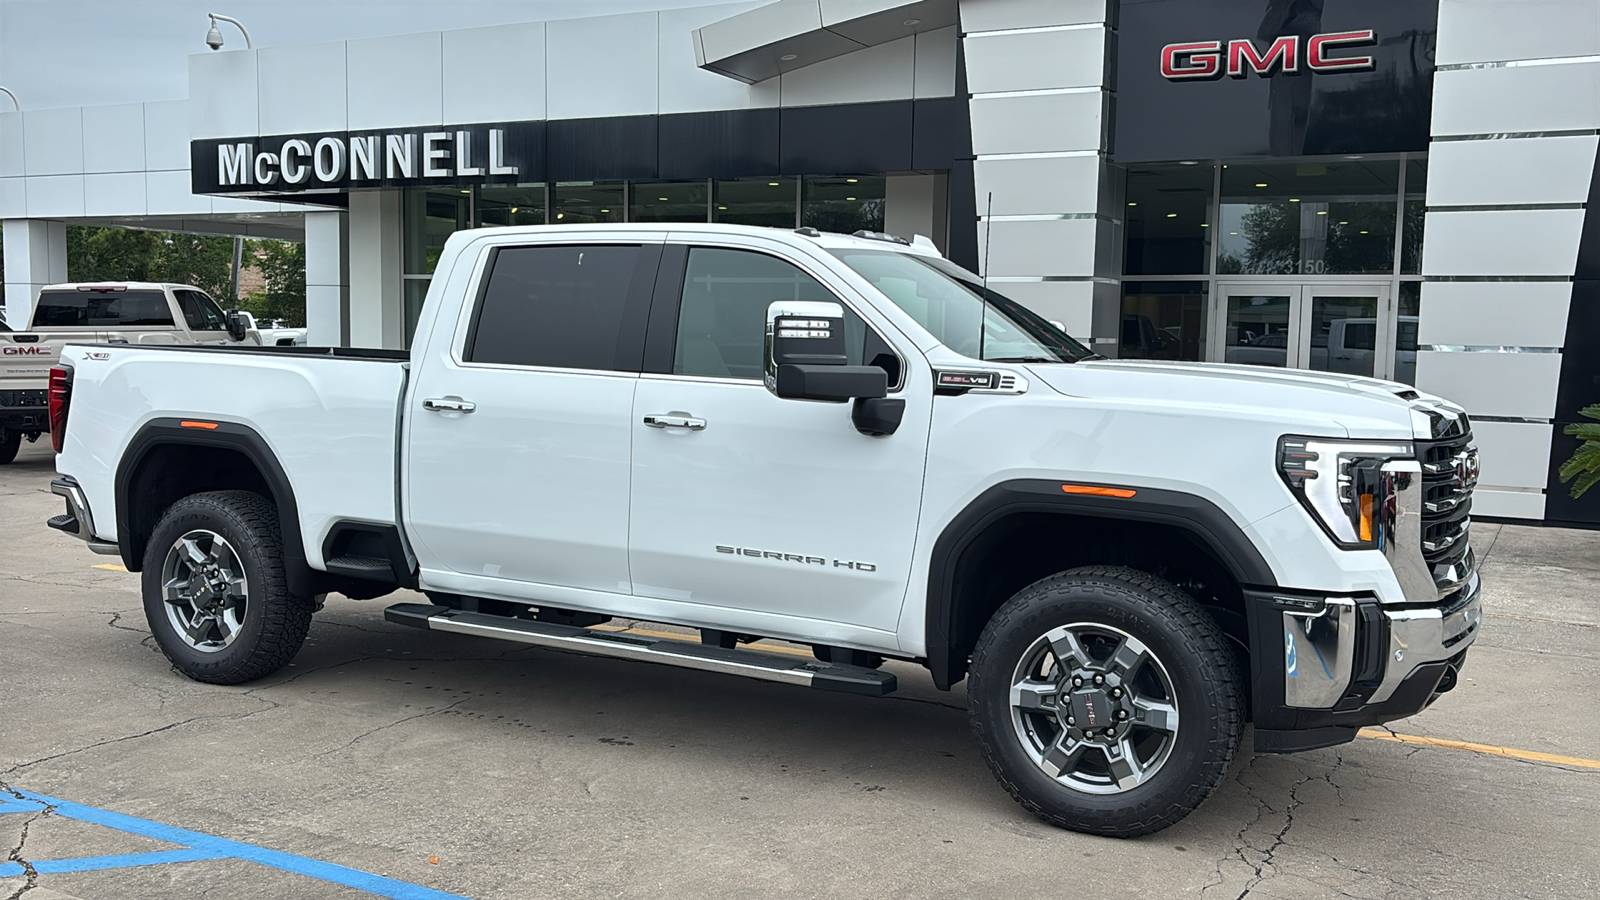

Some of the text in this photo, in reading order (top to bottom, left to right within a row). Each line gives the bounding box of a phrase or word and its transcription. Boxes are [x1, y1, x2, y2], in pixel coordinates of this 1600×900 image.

[1160, 29, 1376, 79] GMC
[217, 129, 518, 186] McCONNELL
[1284, 259, 1324, 274] 3150
[3, 346, 51, 355] GMC
[716, 545, 876, 572] SIERRA HD
